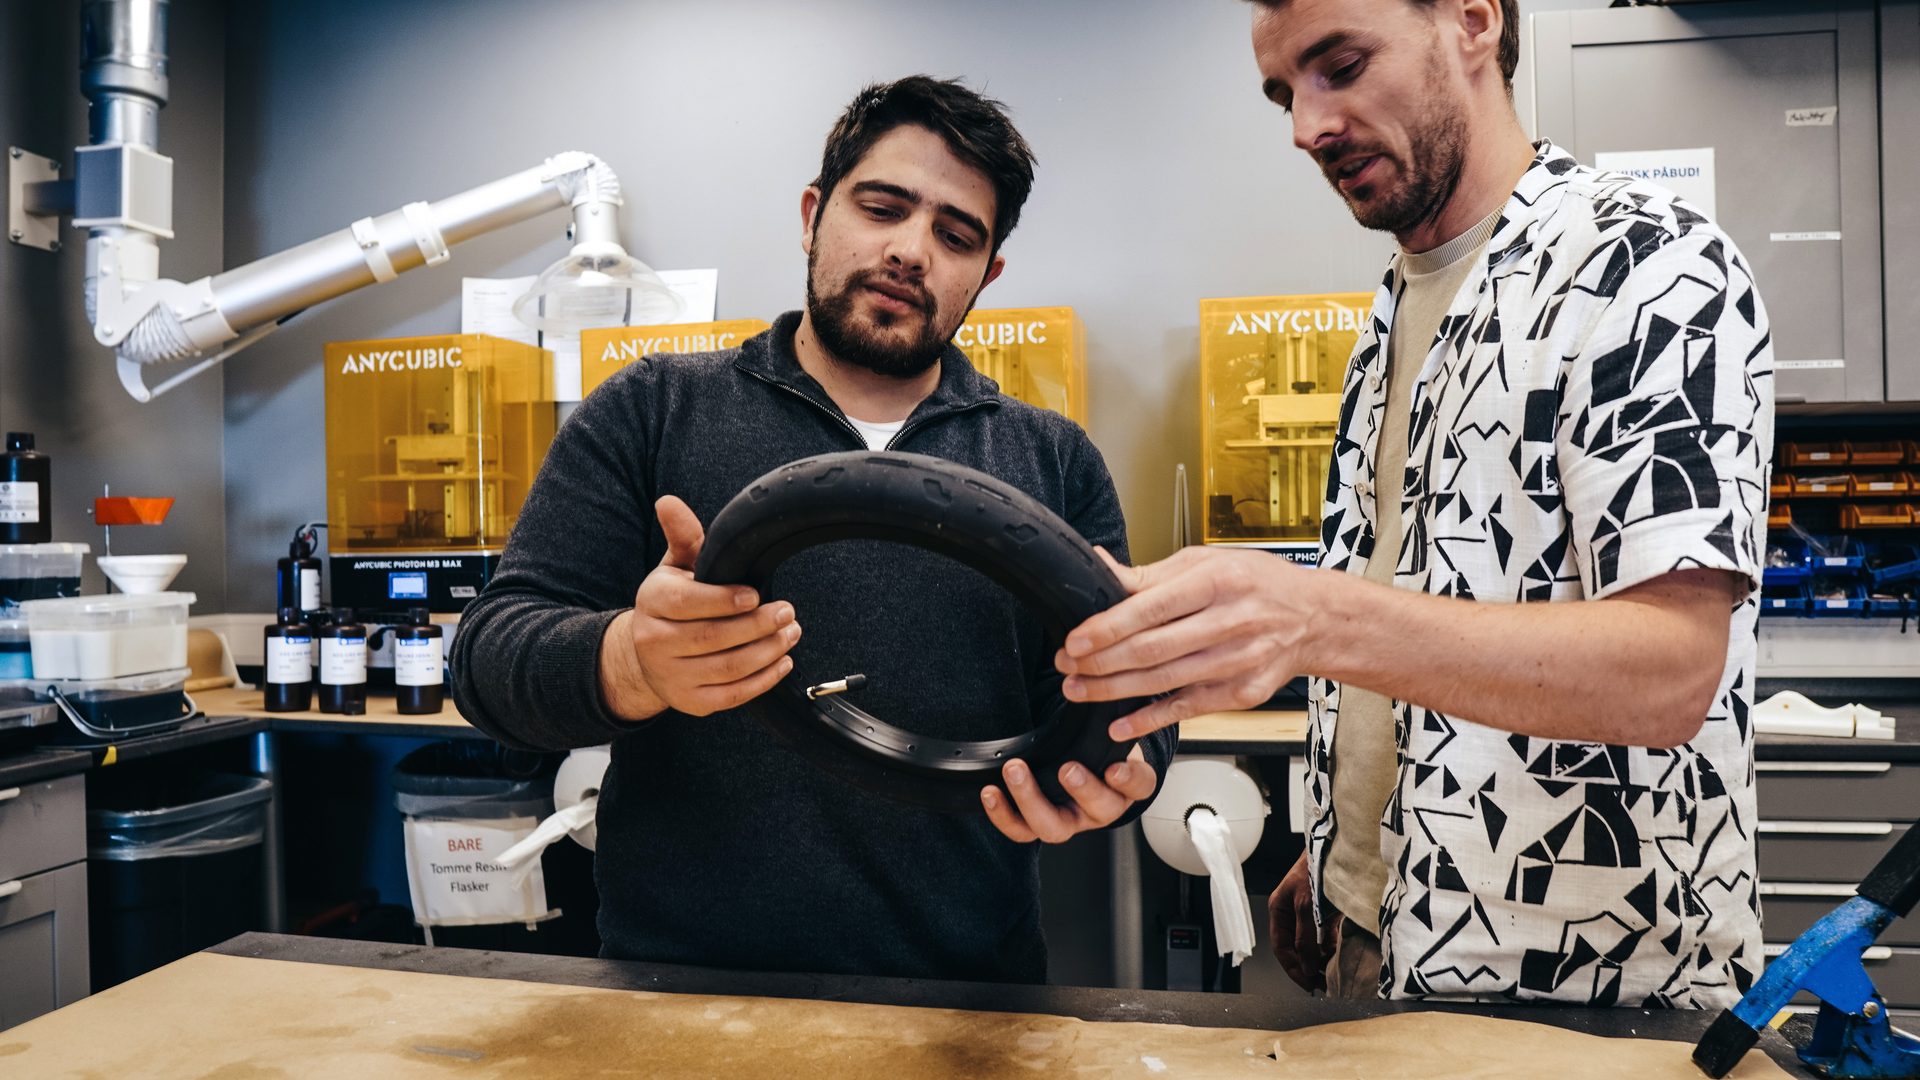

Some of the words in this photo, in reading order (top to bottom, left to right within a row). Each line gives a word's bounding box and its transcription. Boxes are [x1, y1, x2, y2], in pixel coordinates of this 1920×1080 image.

[1616, 170, 1650, 179] USK
[1653, 166, 1700, 179] PÅBUD!
[1227, 307, 1365, 335] ANYCUBI
[955, 321, 1047, 347] CUBIC
[601, 333, 735, 361] ANYCUBIC
[342, 347, 462, 374] ANYCUBIC
[1295, 552, 1319, 562] PHO
[354, 561, 392, 569] ANYCUBIC
[393, 560, 426, 569] PHOTON
[427, 560, 440, 569] M3
[442, 560, 463, 568] MAX
[448, 838, 483, 852] BARE
[430, 862, 472, 874] Tomme
[450, 881, 490, 893] Flasker
